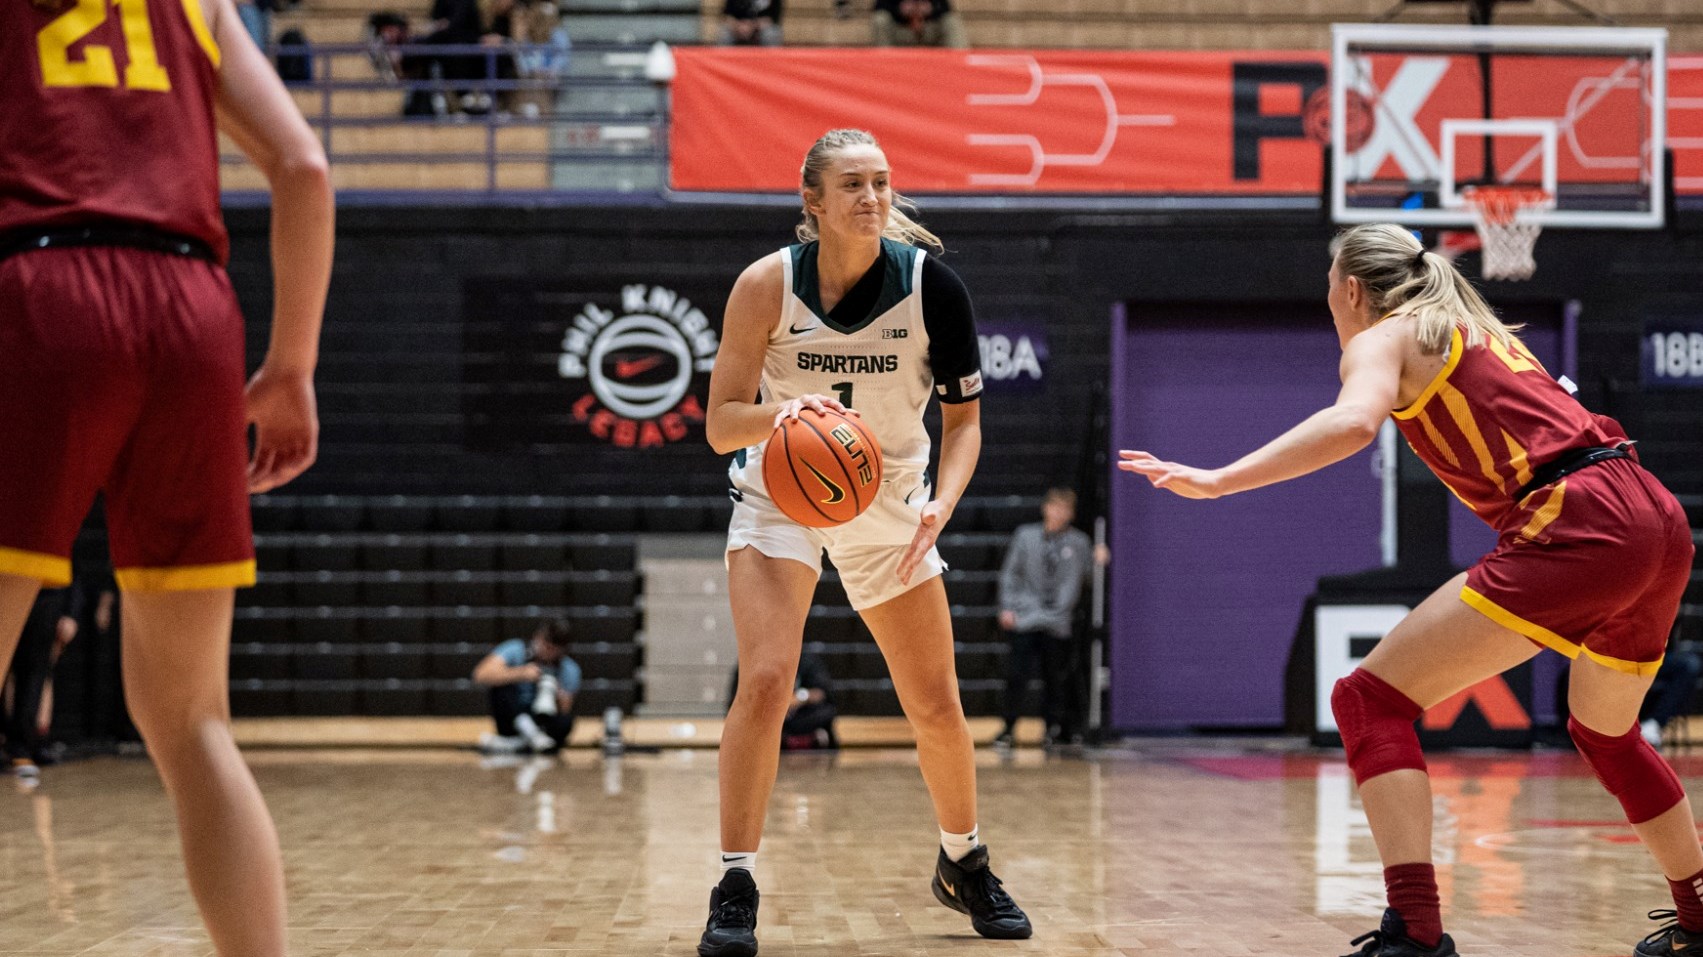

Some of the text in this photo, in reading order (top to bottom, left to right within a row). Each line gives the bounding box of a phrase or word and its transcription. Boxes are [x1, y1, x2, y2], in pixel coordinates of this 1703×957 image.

[36, 0, 172, 92] 21
[557, 302, 615, 378] PHIL
[797, 351, 898, 373] SPARTANS
[572, 394, 706, 448] LEGACY
[830, 423, 873, 487] ELITE
